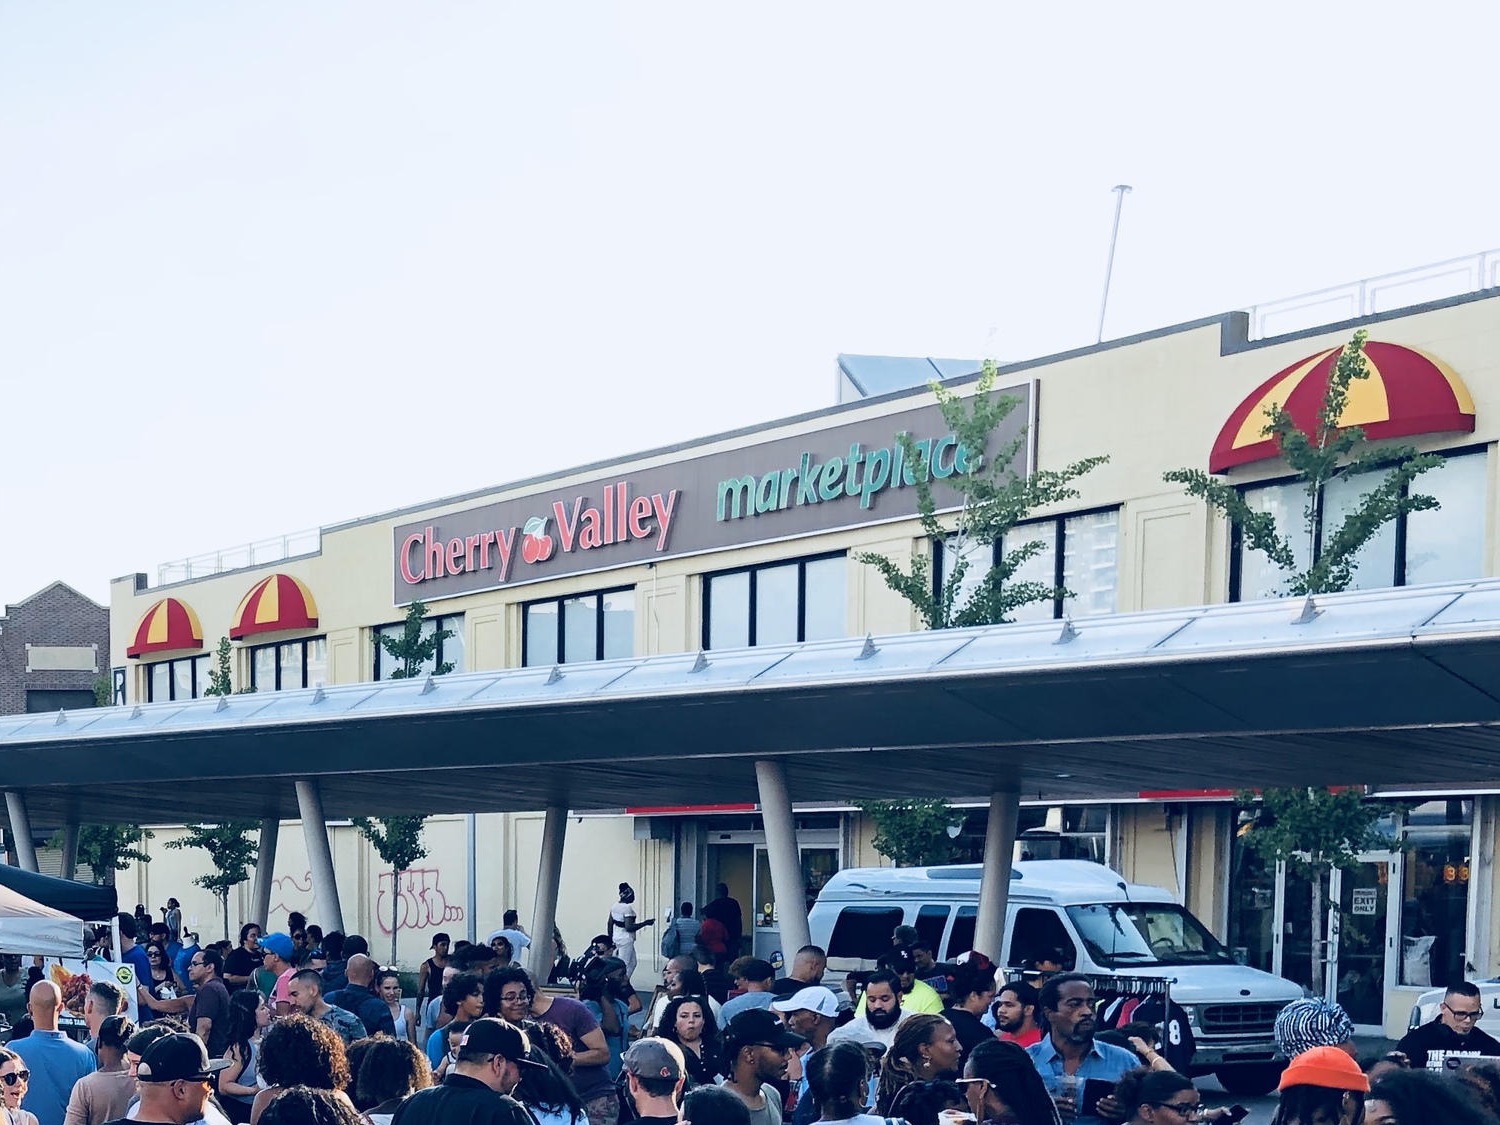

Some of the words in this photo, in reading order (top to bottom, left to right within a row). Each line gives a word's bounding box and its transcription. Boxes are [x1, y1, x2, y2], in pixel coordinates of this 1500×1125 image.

[400, 526, 517, 585] Cherry
[552, 481, 679, 552] Valley
[1354, 897, 1375, 905] EXIT
[1427, 1049, 1445, 1061] THE
